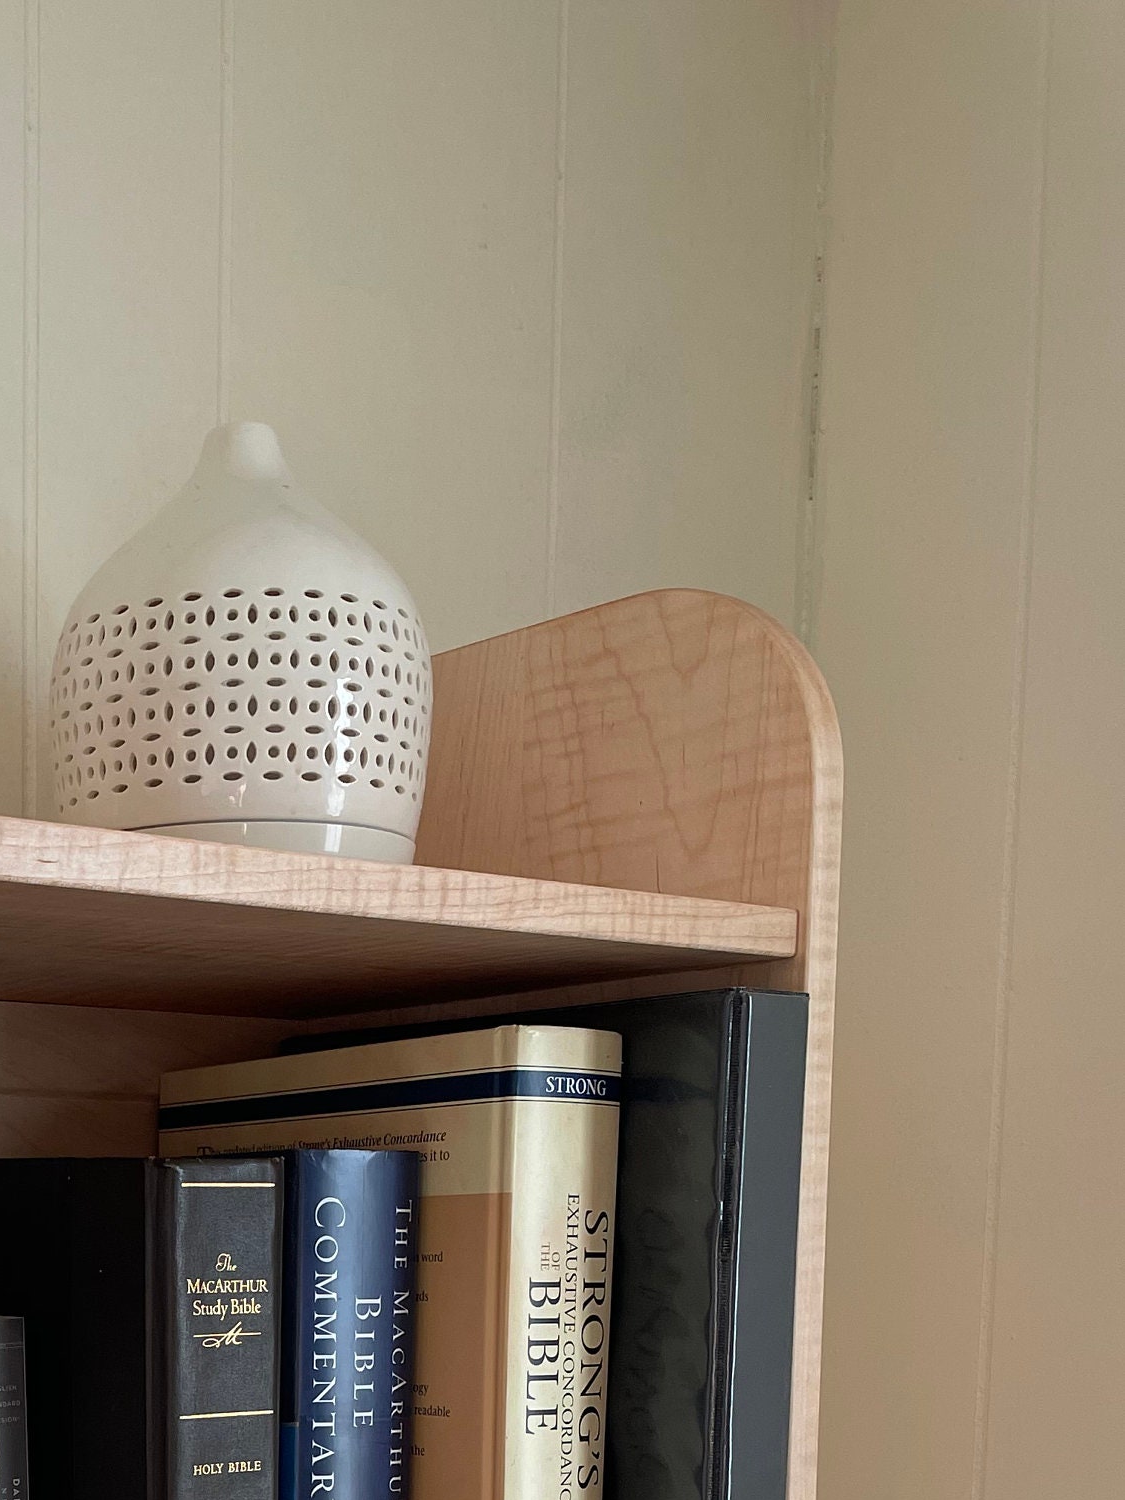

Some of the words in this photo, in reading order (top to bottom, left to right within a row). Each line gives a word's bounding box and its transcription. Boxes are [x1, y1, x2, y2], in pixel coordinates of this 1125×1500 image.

[545, 1076, 607, 1096] STRONG
[333, 1133, 382, 1149] Exhaustive
[383, 1130, 447, 1145] Concordance
[430, 1151, 437, 1161] it
[439, 1151, 450, 1161] to
[394, 1199, 412, 1270] THE
[215, 1253, 237, 1272] The
[421, 1251, 443, 1263] word
[540, 1242, 550, 1271] THE
[551, 1251, 560, 1271] OF
[564, 1193, 580, 1334] EXHAUSTIVE
[192, 1300, 229, 1320] Study
[230, 1300, 262, 1315] Bible
[526, 1277, 562, 1434] BIBLE
[577, 1208, 609, 1489] STRONG'S
[353, 1297, 382, 1428] BIBLE
[414, 1404, 451, 1418] readable
[193, 1463, 224, 1476] HOLY
[228, 1460, 262, 1474] BIBLE
